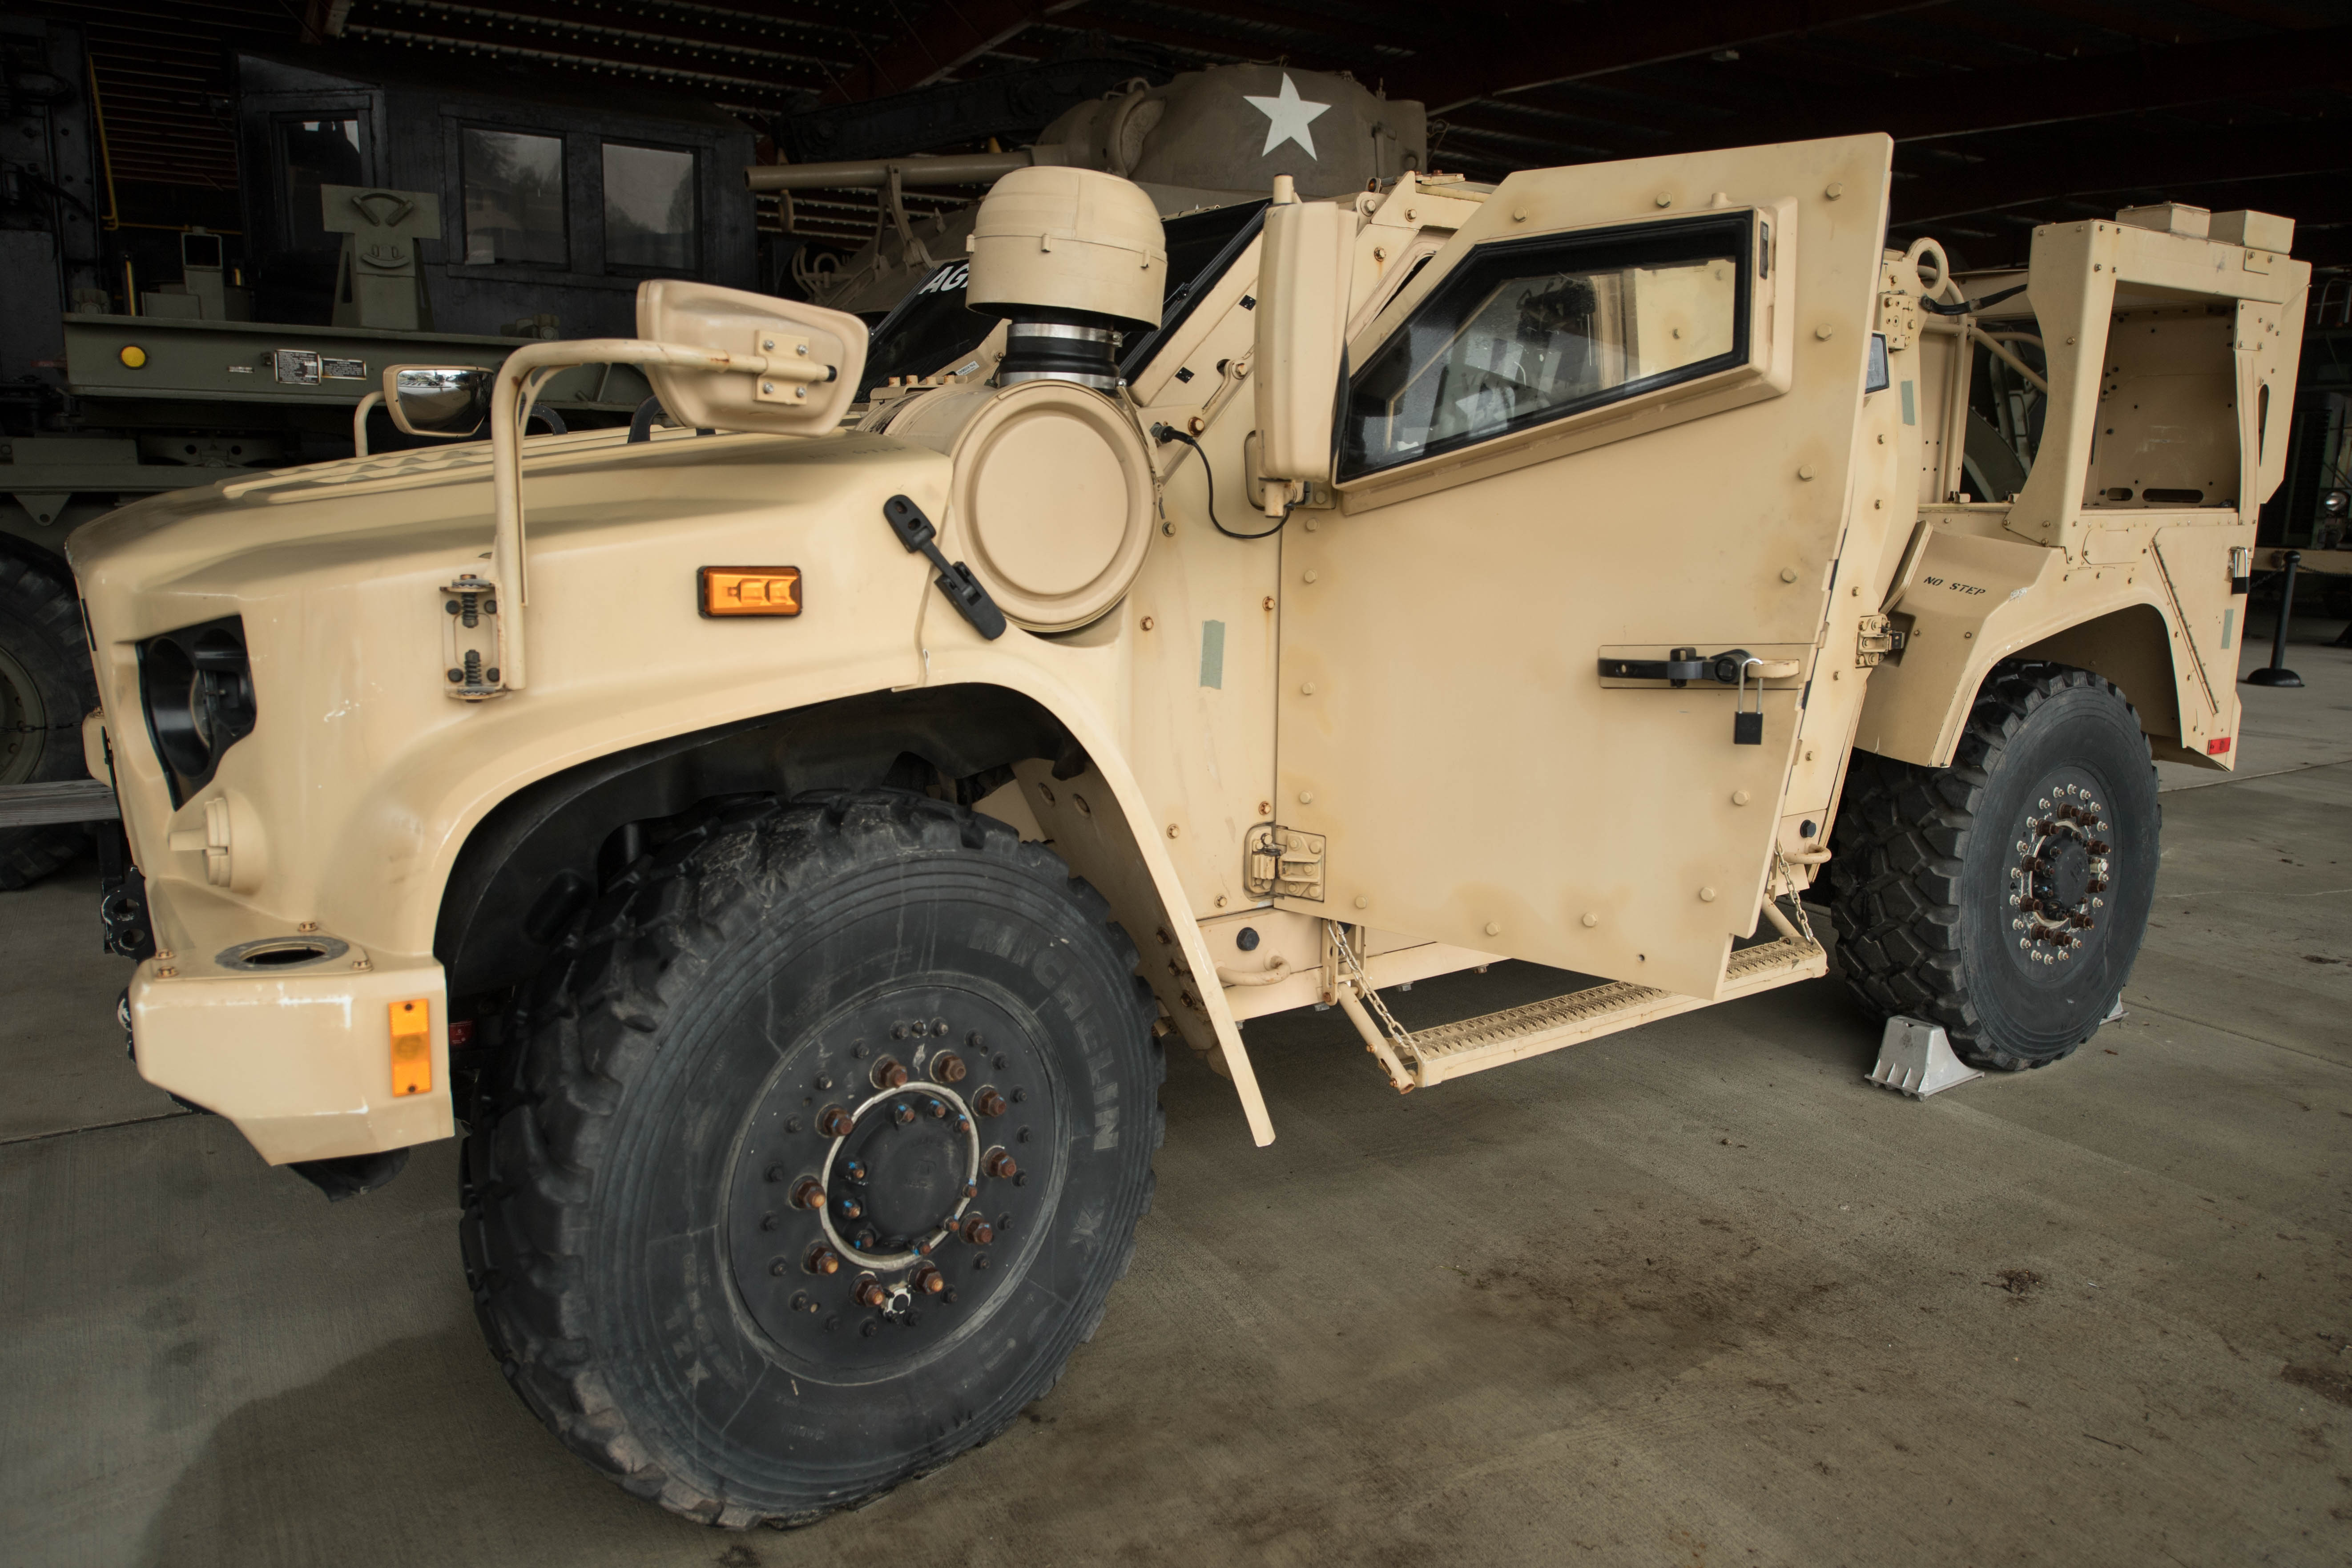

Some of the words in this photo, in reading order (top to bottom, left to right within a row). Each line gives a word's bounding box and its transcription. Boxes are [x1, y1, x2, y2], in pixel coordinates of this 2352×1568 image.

[1923, 576, 1943, 586] NO
[1949, 583, 1986, 595] STEP
[967, 917, 1120, 1151] MICHELIN
